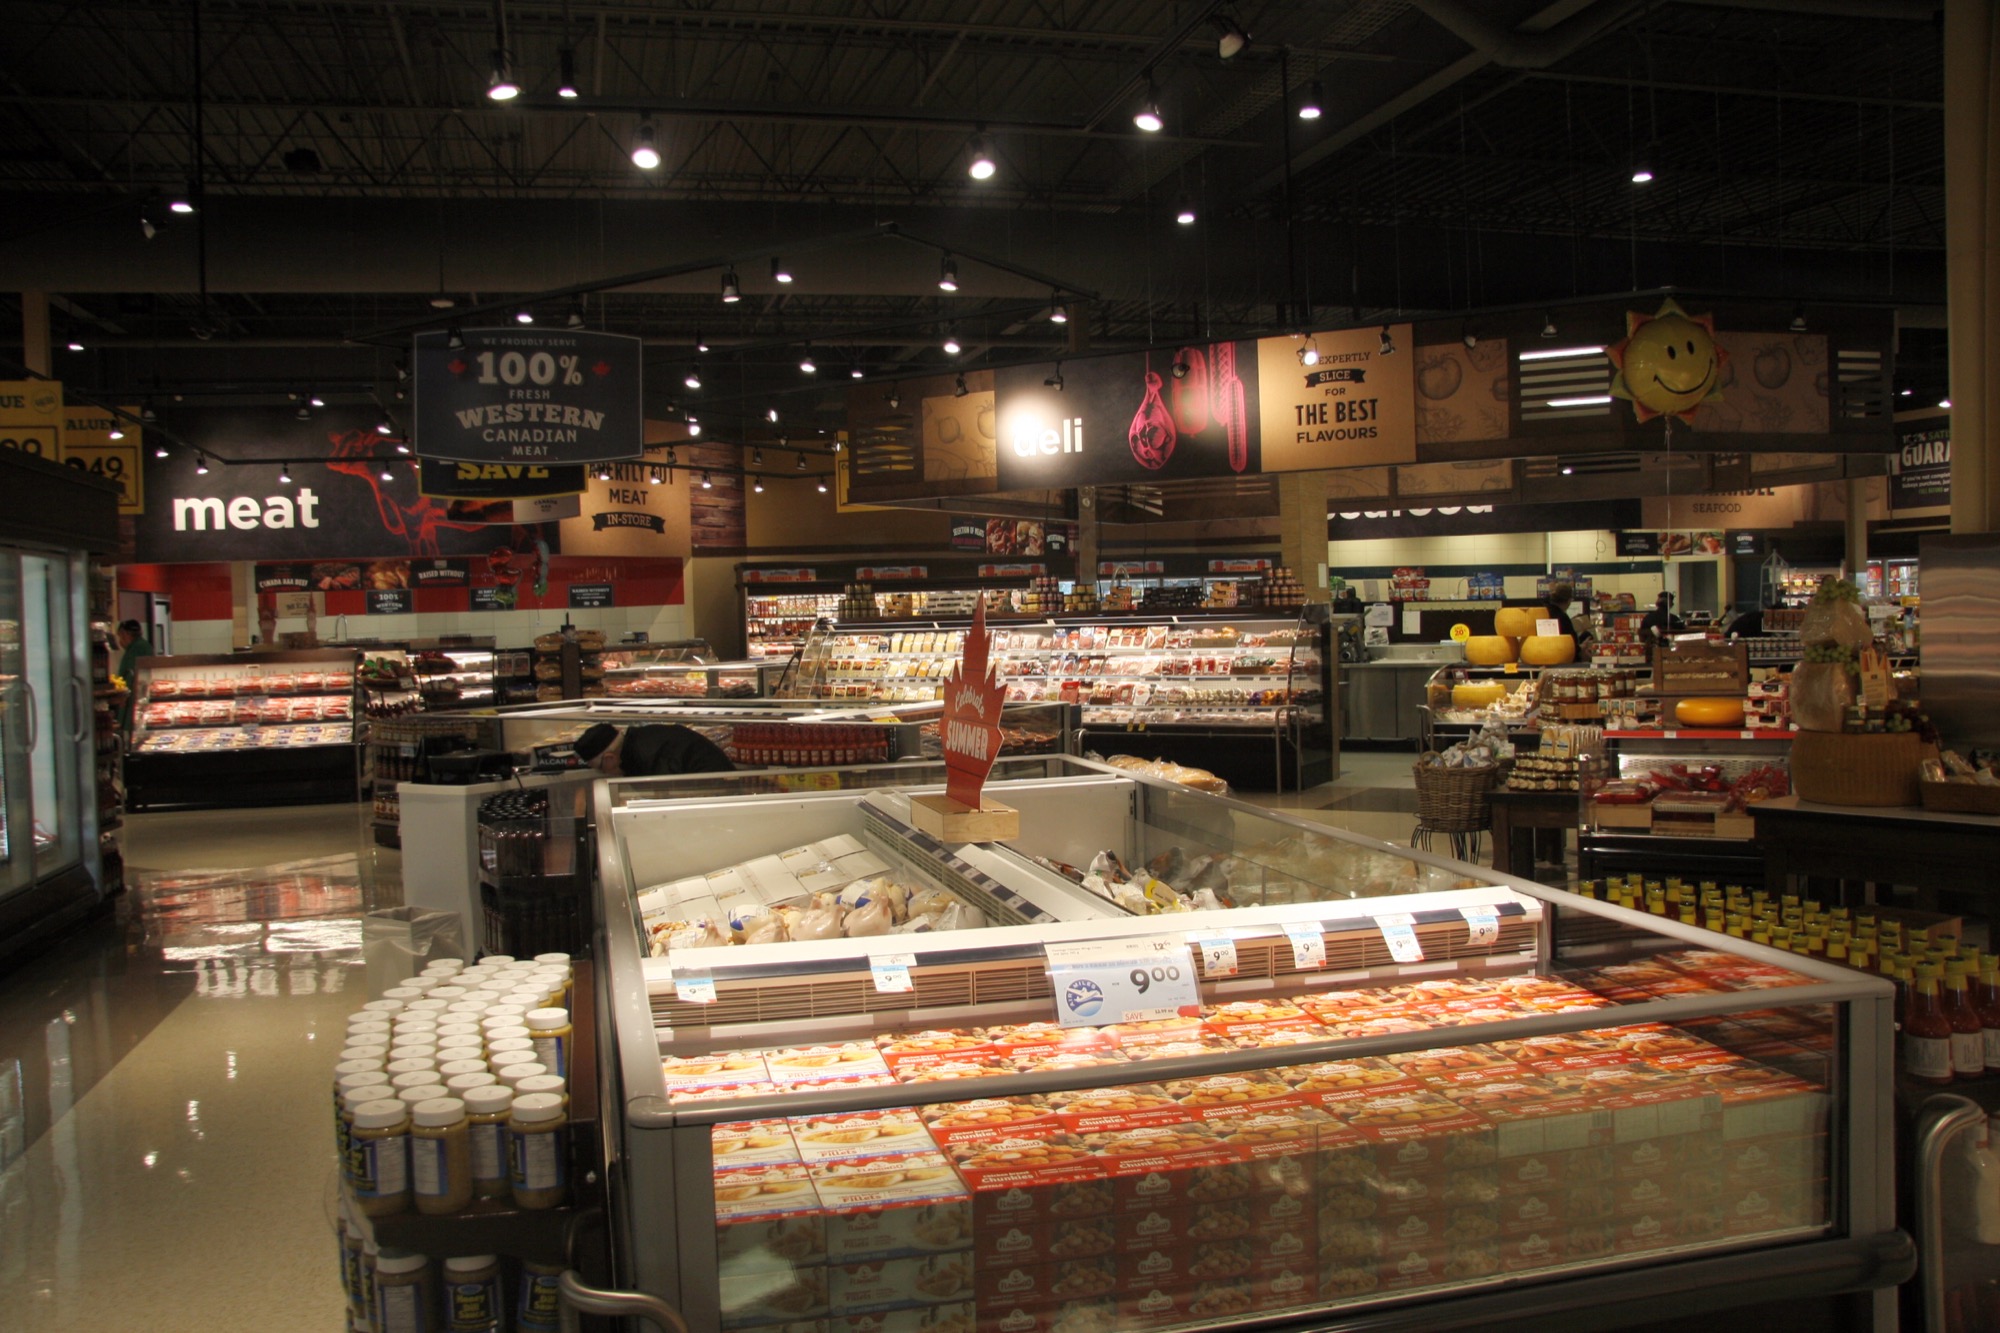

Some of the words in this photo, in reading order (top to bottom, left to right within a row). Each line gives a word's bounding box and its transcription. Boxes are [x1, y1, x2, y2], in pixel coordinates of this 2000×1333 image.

[482, 337, 497, 345] WE
[501, 338, 543, 346] PROUDLY
[548, 338, 577, 346] SERVE
[1318, 352, 1371, 365] EXPERTLY
[477, 352, 582, 385] 100%
[1320, 371, 1351, 381] SLICE
[509, 389, 550, 399] FRESH
[1325, 388, 1346, 396] FOR
[456, 403, 605, 430] WESTERN
[1295, 403, 1328, 426] THE
[1336, 399, 1378, 423] BEST
[483, 429, 577, 442] CANADIAN
[1013, 417, 1083, 457] deli
[1297, 427, 1378, 443] FLAVOURS
[512, 446, 549, 456] MEAT
[609, 488, 648, 505] MEAT
[173, 488, 319, 531] meat
[1692, 503, 1742, 513] SEAFOOD
[607, 514, 652, 526] IN-STORE
[419, 571, 438, 579] RAISED
[439, 570, 464, 578] WITHOUT
[946, 720, 988, 761] SUMMER
[1073, 981, 1096, 990] MILES
[1068, 992, 1076, 1007] AIR
[1125, 1012, 1143, 1021] SAVE
[963, 1101, 1005, 1110] FLAMINGO
[835, 1121, 879, 1129] FLAMINGO
[1079, 1118, 1125, 1126] Chunkies
[949, 1132, 997, 1141] Chunkies
[995, 1141, 1040, 1150] FLAMINGO
[857, 1164, 903, 1173] FLAMINGO
[981, 1174, 1034, 1183] Chunkies
[842, 1194, 882, 1202] Fillets
